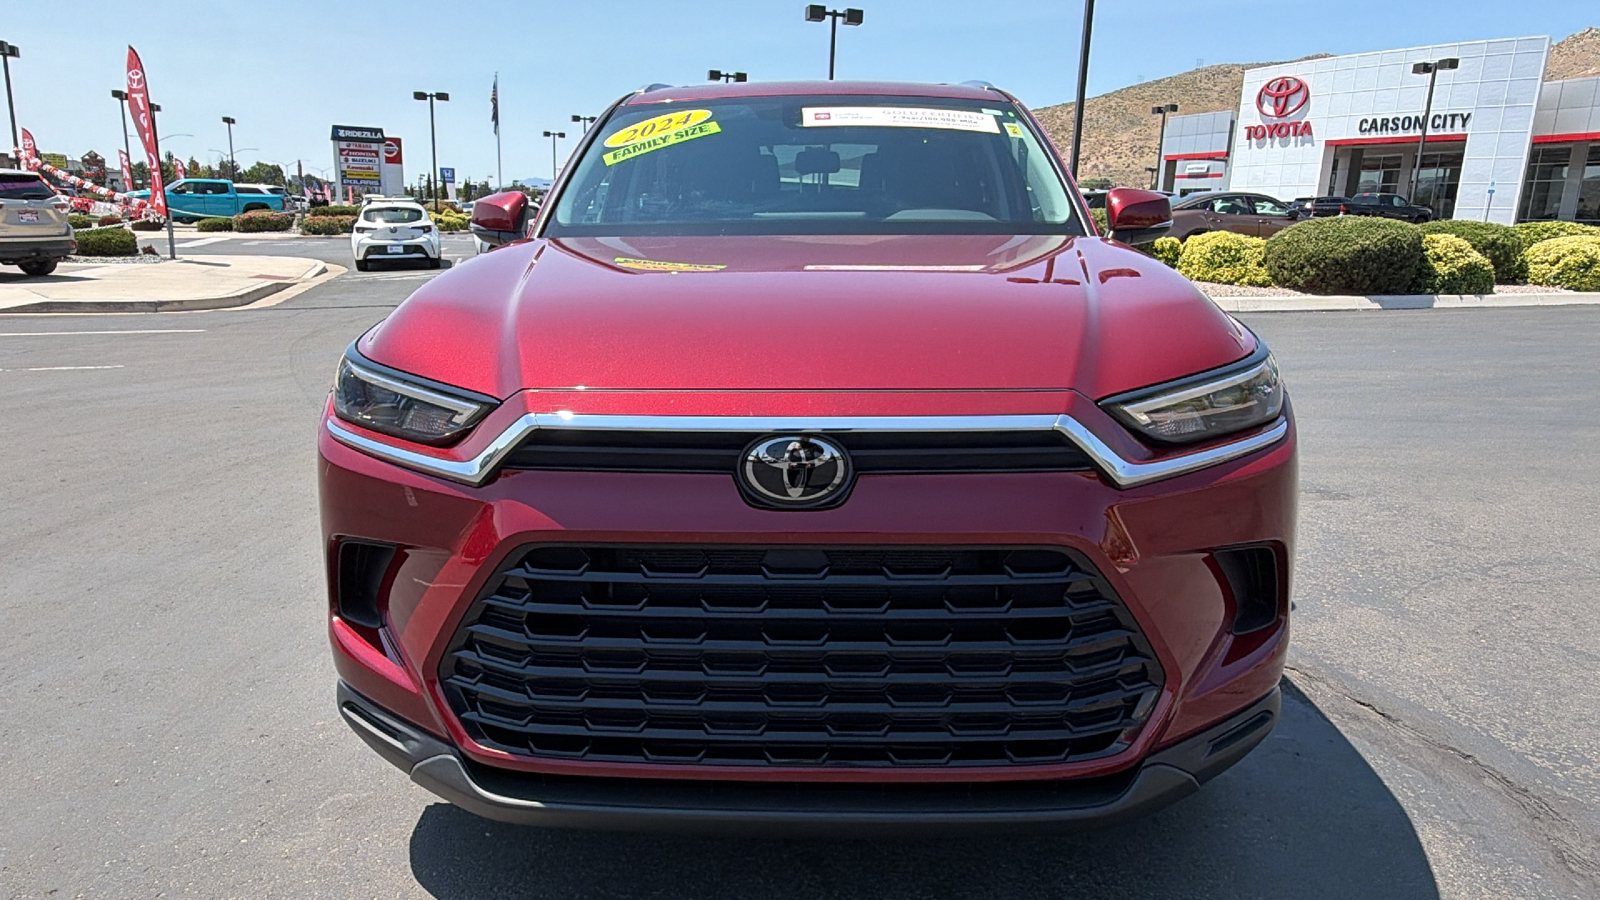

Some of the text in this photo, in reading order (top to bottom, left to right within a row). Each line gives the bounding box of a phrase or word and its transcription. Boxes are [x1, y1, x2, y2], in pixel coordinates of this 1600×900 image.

[921, 111, 984, 120] CERTIFIED
[1358, 112, 1472, 133] CARSON CITY
[345, 130, 382, 138] RIDEZILLA
[623, 113, 693, 143] 2024
[1245, 121, 1313, 140] TOYOTA
[612, 125, 710, 160] FAMILY SIZE
